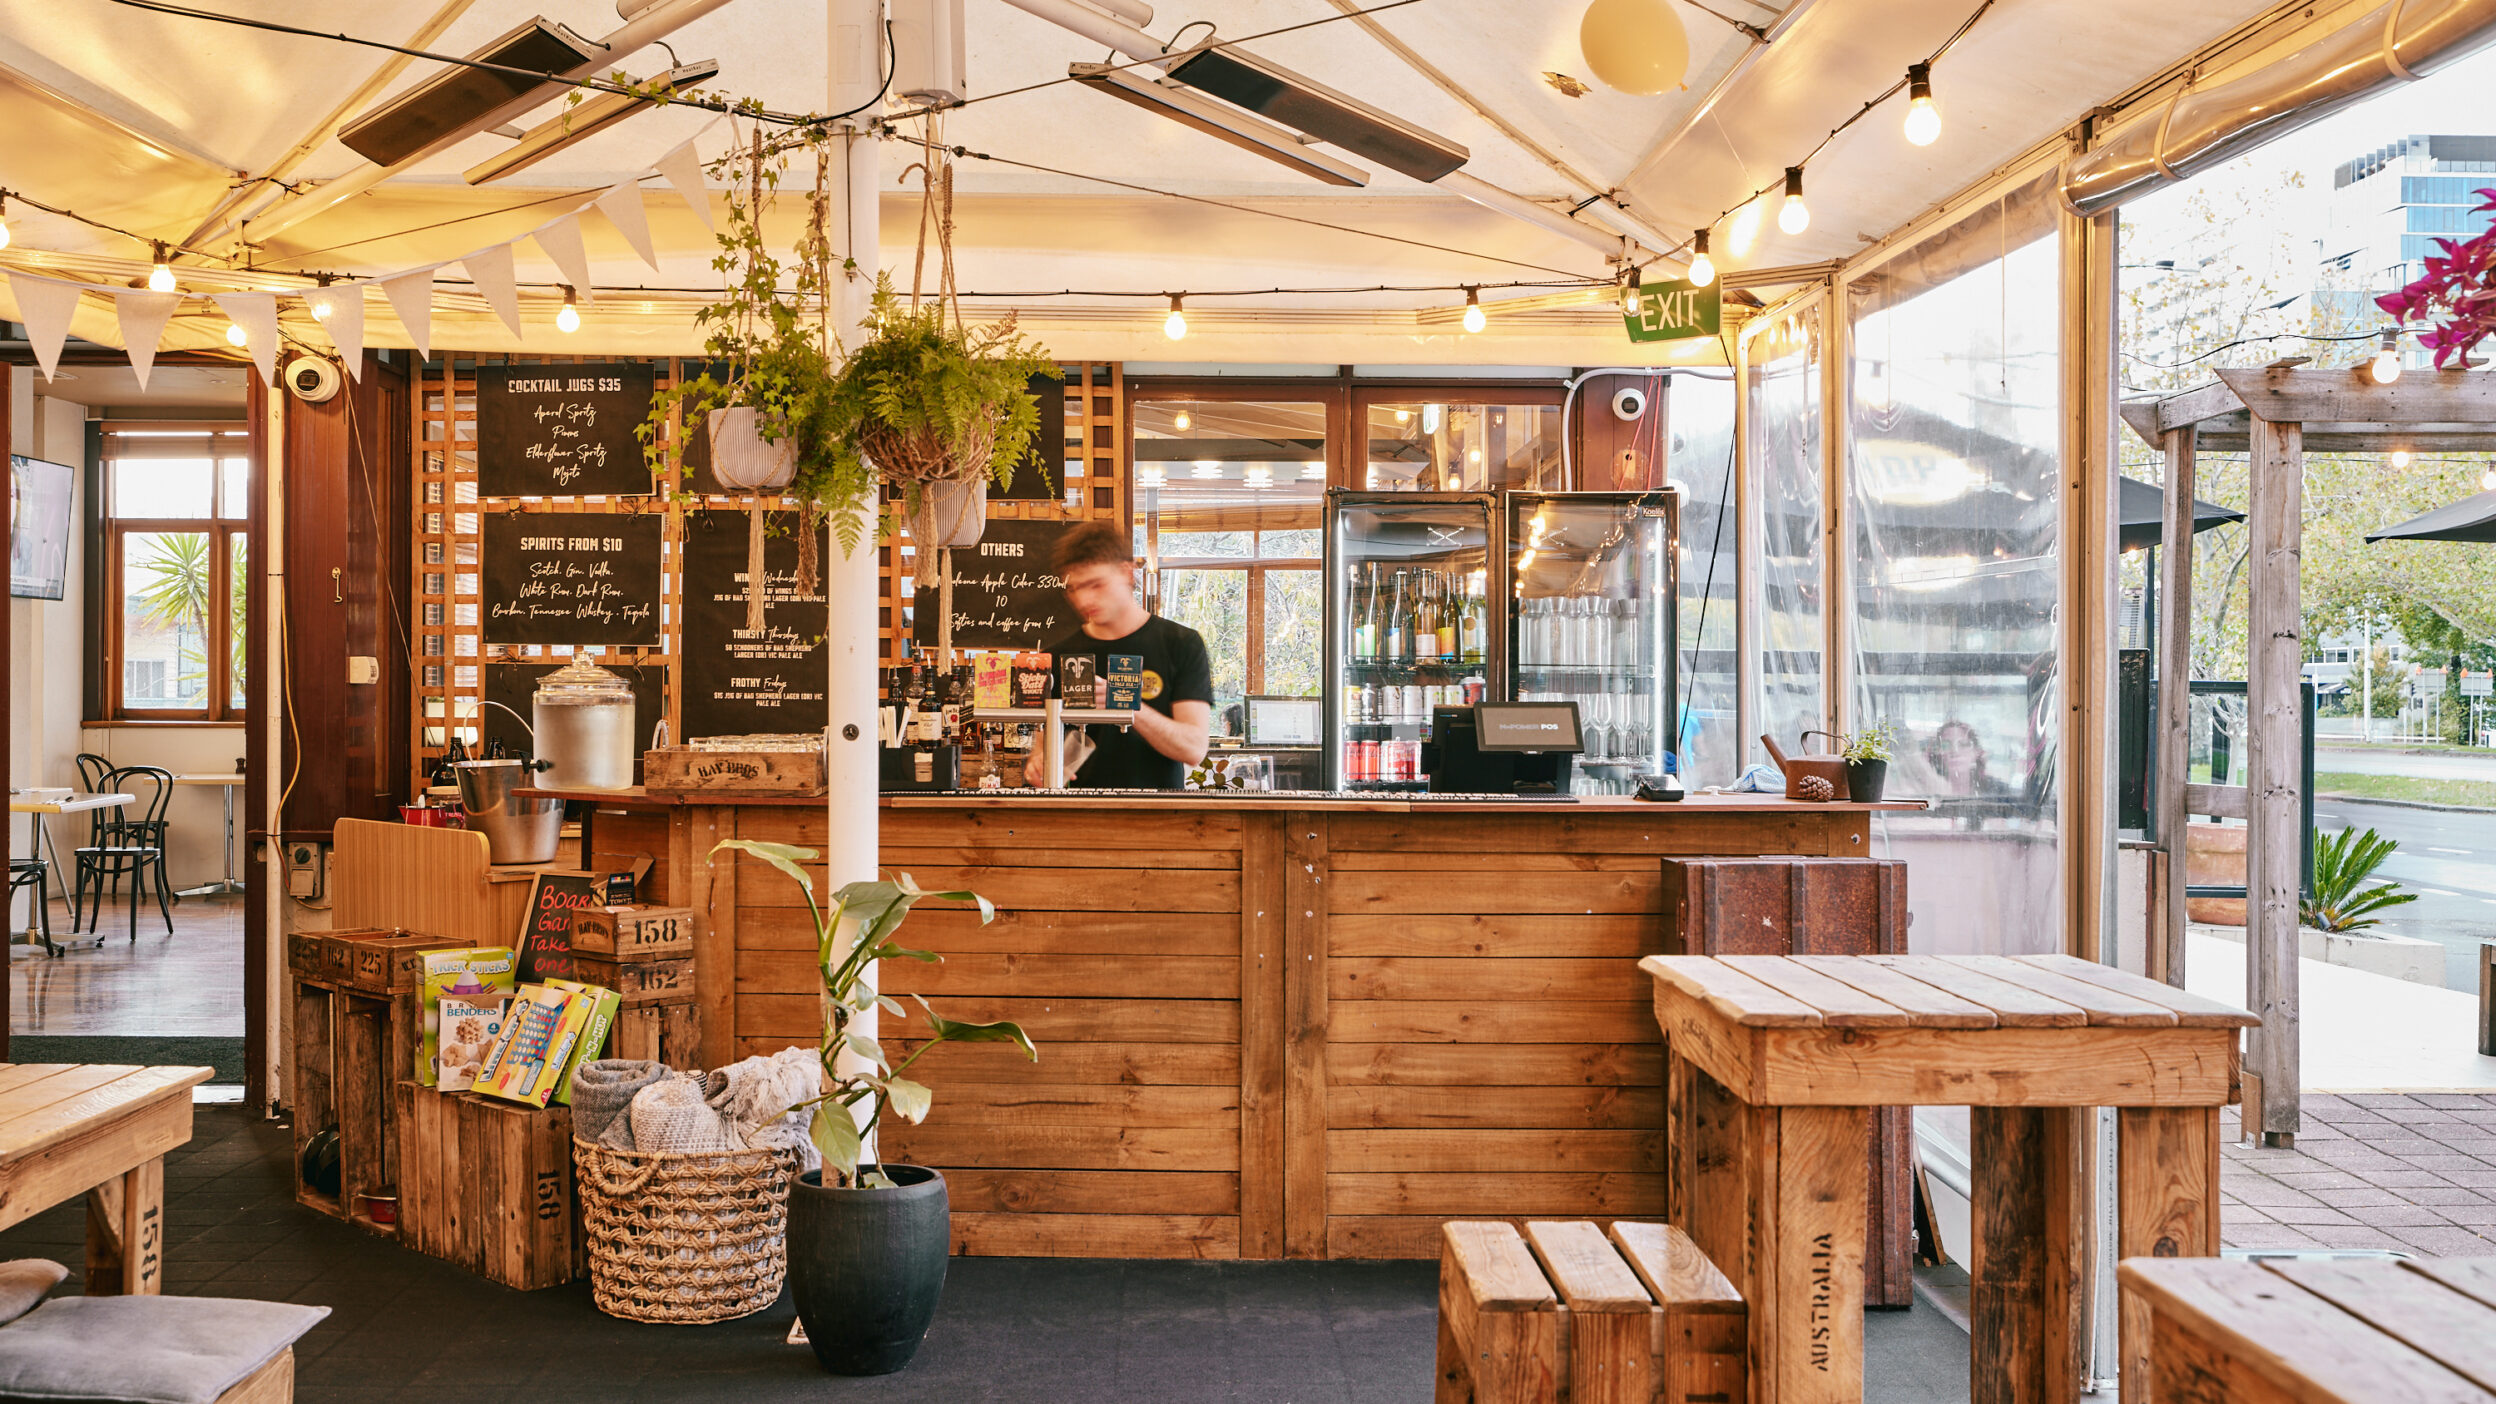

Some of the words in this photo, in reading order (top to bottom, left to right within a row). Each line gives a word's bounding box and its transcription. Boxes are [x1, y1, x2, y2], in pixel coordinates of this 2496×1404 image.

[1640, 288, 1700, 332] EXIT
[508, 378, 562, 393] COCKTAIL
[566, 378, 594, 393] JUGS
[599, 377, 621, 392] $35
[534, 402, 564, 424] Aperol
[566, 402, 597, 427] Spritz
[552, 425, 580, 439] Pimms
[526, 443, 573, 463] Elderflower
[576, 442, 607, 467] Spritz
[553, 463, 581, 486] Mojito
[520, 537, 564, 551] SPIRITS
[568, 537, 599, 551] FROM
[602, 537, 623, 552] $10
[980, 543, 1024, 557] OTHERS
[519, 580, 547, 598] White
[575, 580, 599, 598] Dark
[981, 572, 1008, 593] Apple
[1011, 572, 1035, 588] Cider
[995, 595, 1008, 608] 10
[528, 603, 572, 619] Tennessee
[622, 603, 650, 625] Tequila
[978, 612, 995, 627] and
[996, 616, 1022, 632] coffee
[1024, 617, 1042, 632] from
[1046, 615, 1055, 629] 4
[732, 629, 765, 639] THIRSTY
[768, 625, 799, 645] Thursdays
[778, 651, 792, 659] PALE
[792, 651, 803, 659] ALE
[730, 677, 761, 688] FROTHY
[763, 674, 787, 693] Fridays
[1018, 672, 1048, 683] Sticky
[1021, 680, 1045, 689] Date
[1109, 674, 1139, 683] VICTORIA
[1064, 685, 1093, 693] LAGER
[755, 699, 770, 707] PALE
[770, 699, 781, 707] ALE
[1541, 723, 1559, 731] POS
[698, 762, 723, 778] HAY
[727, 761, 760, 779] BROS
[634, 918, 678, 945] 158
[530, 935, 570, 952] Take
[360, 950, 381, 976] 225
[431, 959, 467, 976] TRICK
[469, 959, 511, 975] STICKS
[534, 957, 572, 973] one
[639, 967, 679, 991] 162
[446, 1007, 497, 1017] BENDERS
[538, 1169, 561, 1220] 158
[141, 1204, 158, 1282] 158
[1811, 1233, 1832, 1372] AUSTRALIA
